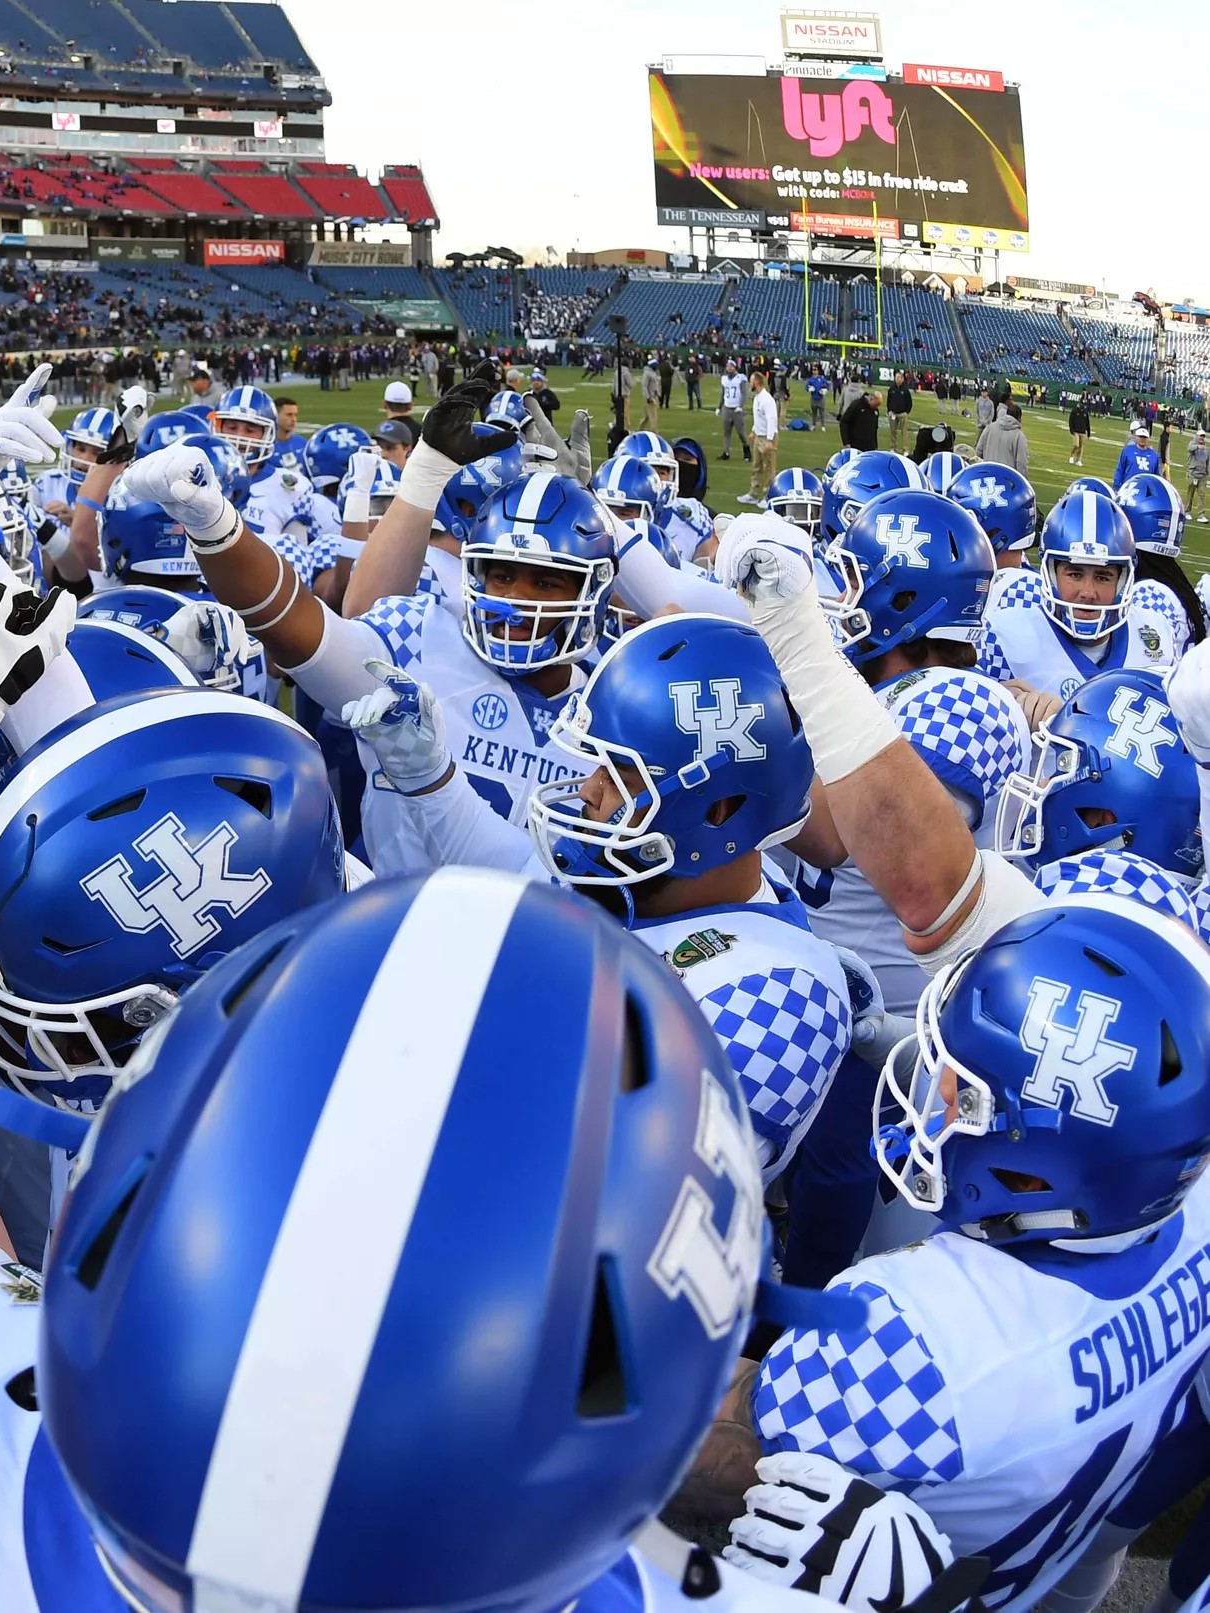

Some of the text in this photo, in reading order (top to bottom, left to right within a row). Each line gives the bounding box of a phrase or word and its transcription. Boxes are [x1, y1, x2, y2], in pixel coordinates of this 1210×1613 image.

[794, 24, 868, 37] NISSAN
[809, 37, 854, 46] STADIUM
[916, 68, 991, 88] NISSAN
[780, 76, 896, 157] lyft
[690, 162, 724, 179] New
[725, 166, 770, 180] users:
[772, 165, 801, 182] Get
[802, 169, 822, 187] up
[823, 169, 840, 185] to
[843, 167, 866, 188] $15
[868, 174, 882, 188] in
[884, 176, 912, 190] free
[913, 176, 938, 192] ride
[777, 186, 808, 199] with
[809, 187, 840, 199] code:
[662, 208, 760, 224] THE TENNESSEAN
[815, 216, 843, 225] Bureau
[845, 218, 896, 231] INSURANCE
[208, 243, 281, 257] NISSAN
[318, 251, 405, 265] MUSIC CITY BOWL
[875, 513, 932, 569] UK
[472, 693, 509, 730] SEC
[668, 677, 767, 763] UK
[1104, 685, 1178, 780] UK
[79, 811, 273, 961] UK
[1019, 976, 1138, 1126] UK
[1069, 1243, 1210, 1425] SCHLEGE
